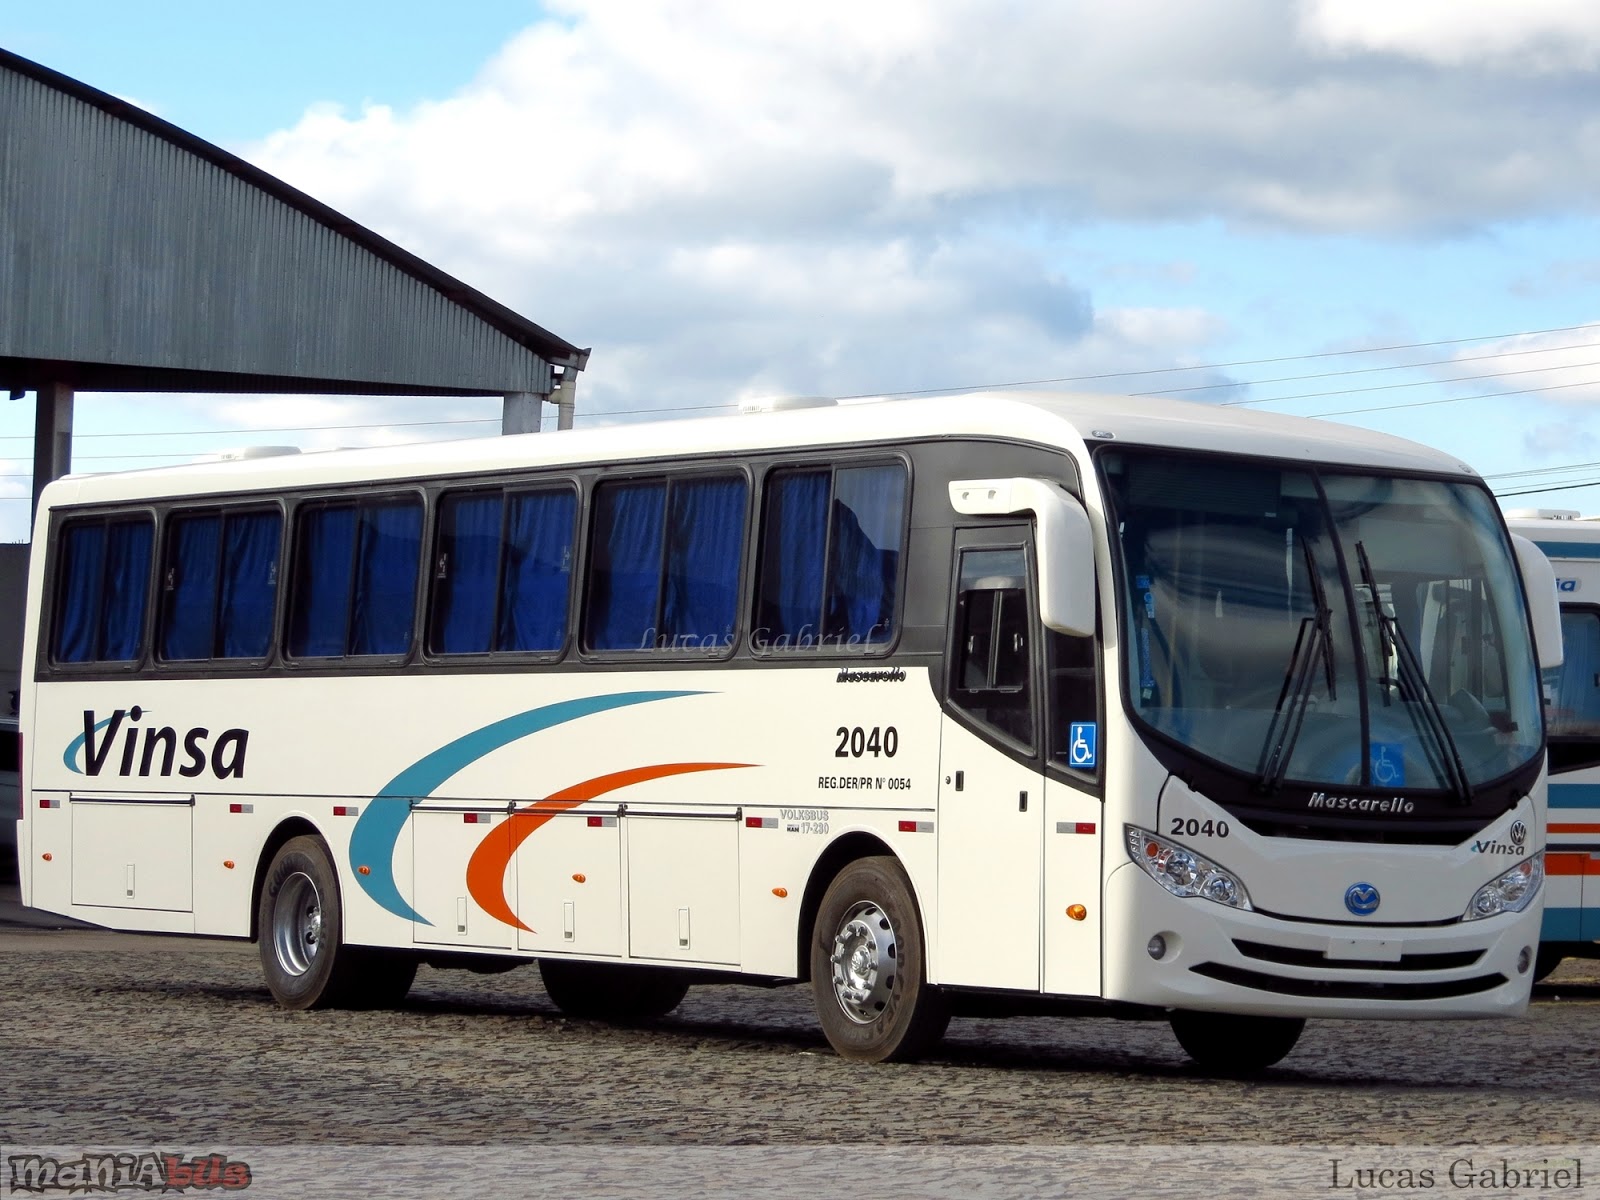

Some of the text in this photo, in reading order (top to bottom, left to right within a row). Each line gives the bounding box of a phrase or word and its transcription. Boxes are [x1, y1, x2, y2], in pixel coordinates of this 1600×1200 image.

[83, 705, 249, 779] Vinsa
[835, 726, 898, 758] 2040
[818, 776, 873, 790] REG.DER/PR
[888, 778, 911, 790] 0054
[1308, 792, 1414, 813] Mascarello
[780, 809, 829, 821] VOLKSBUS
[1170, 817, 1230, 838] 2040
[1475, 839, 1525, 856] Vinsa
